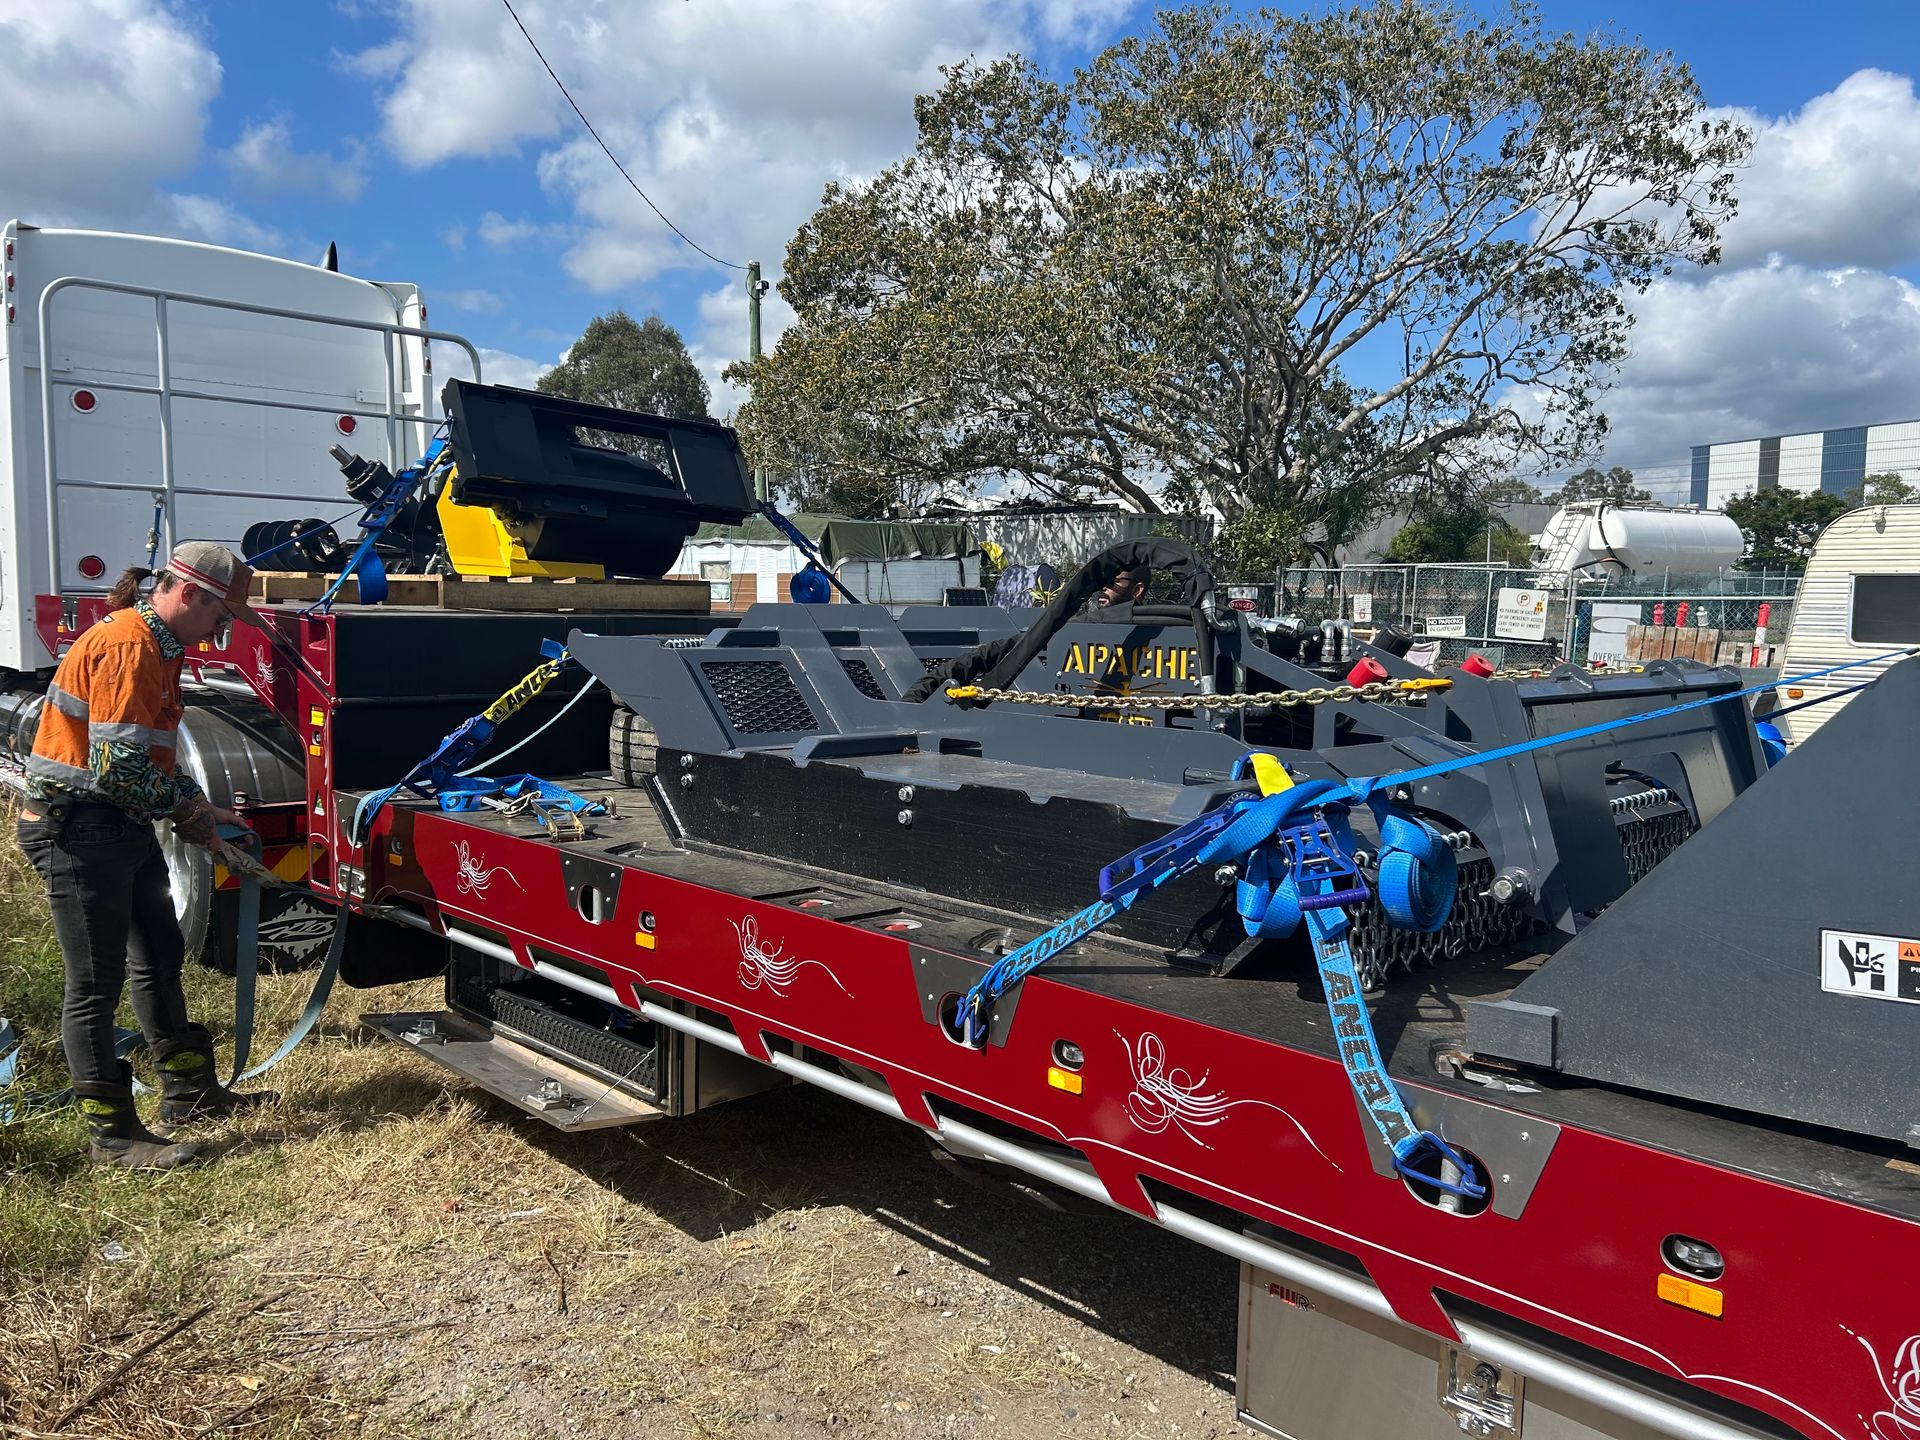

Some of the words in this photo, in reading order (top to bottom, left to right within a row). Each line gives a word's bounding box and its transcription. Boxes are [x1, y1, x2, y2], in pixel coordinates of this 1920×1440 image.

[1231, 601, 1254, 609] DANGER
[1062, 642, 1198, 681] APACHE
[1322, 968, 1413, 1146] ANCRA
